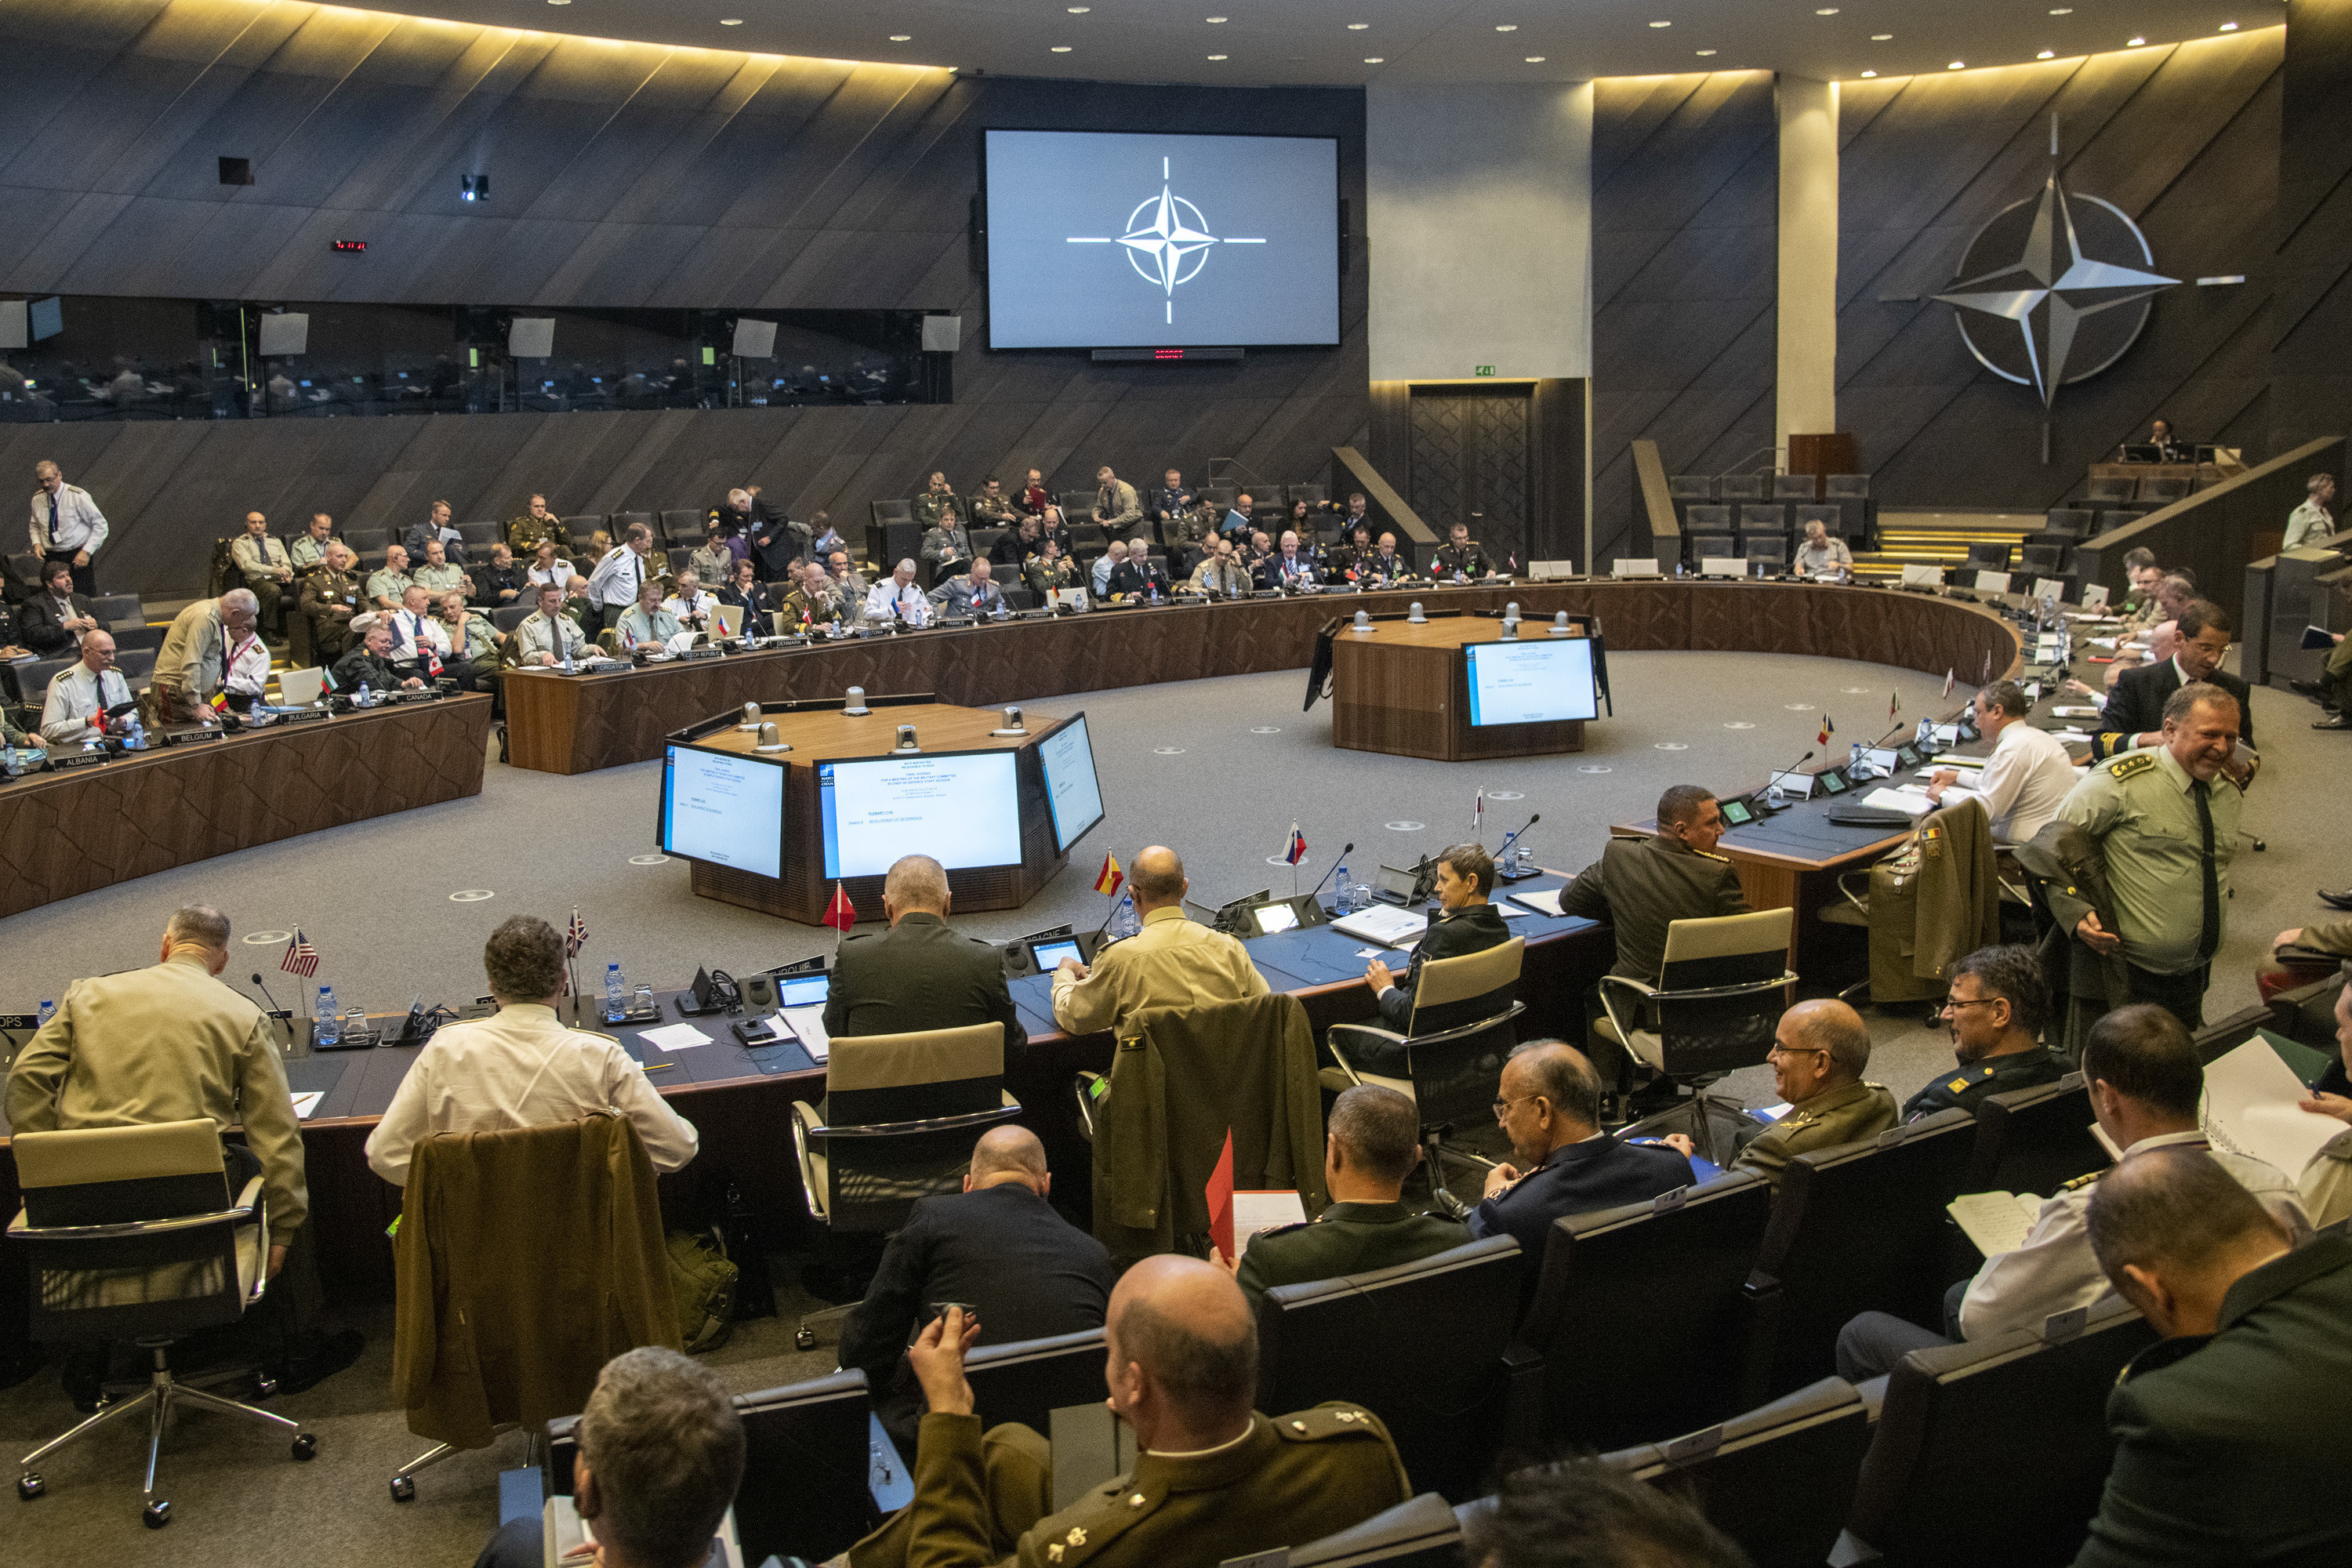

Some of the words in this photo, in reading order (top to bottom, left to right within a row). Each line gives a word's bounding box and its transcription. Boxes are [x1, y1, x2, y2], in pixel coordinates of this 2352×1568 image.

[289, 712, 321, 720] BULGARIA
[181, 732, 212, 742] BELGIUM
[67, 756, 99, 766] ALBANIA
